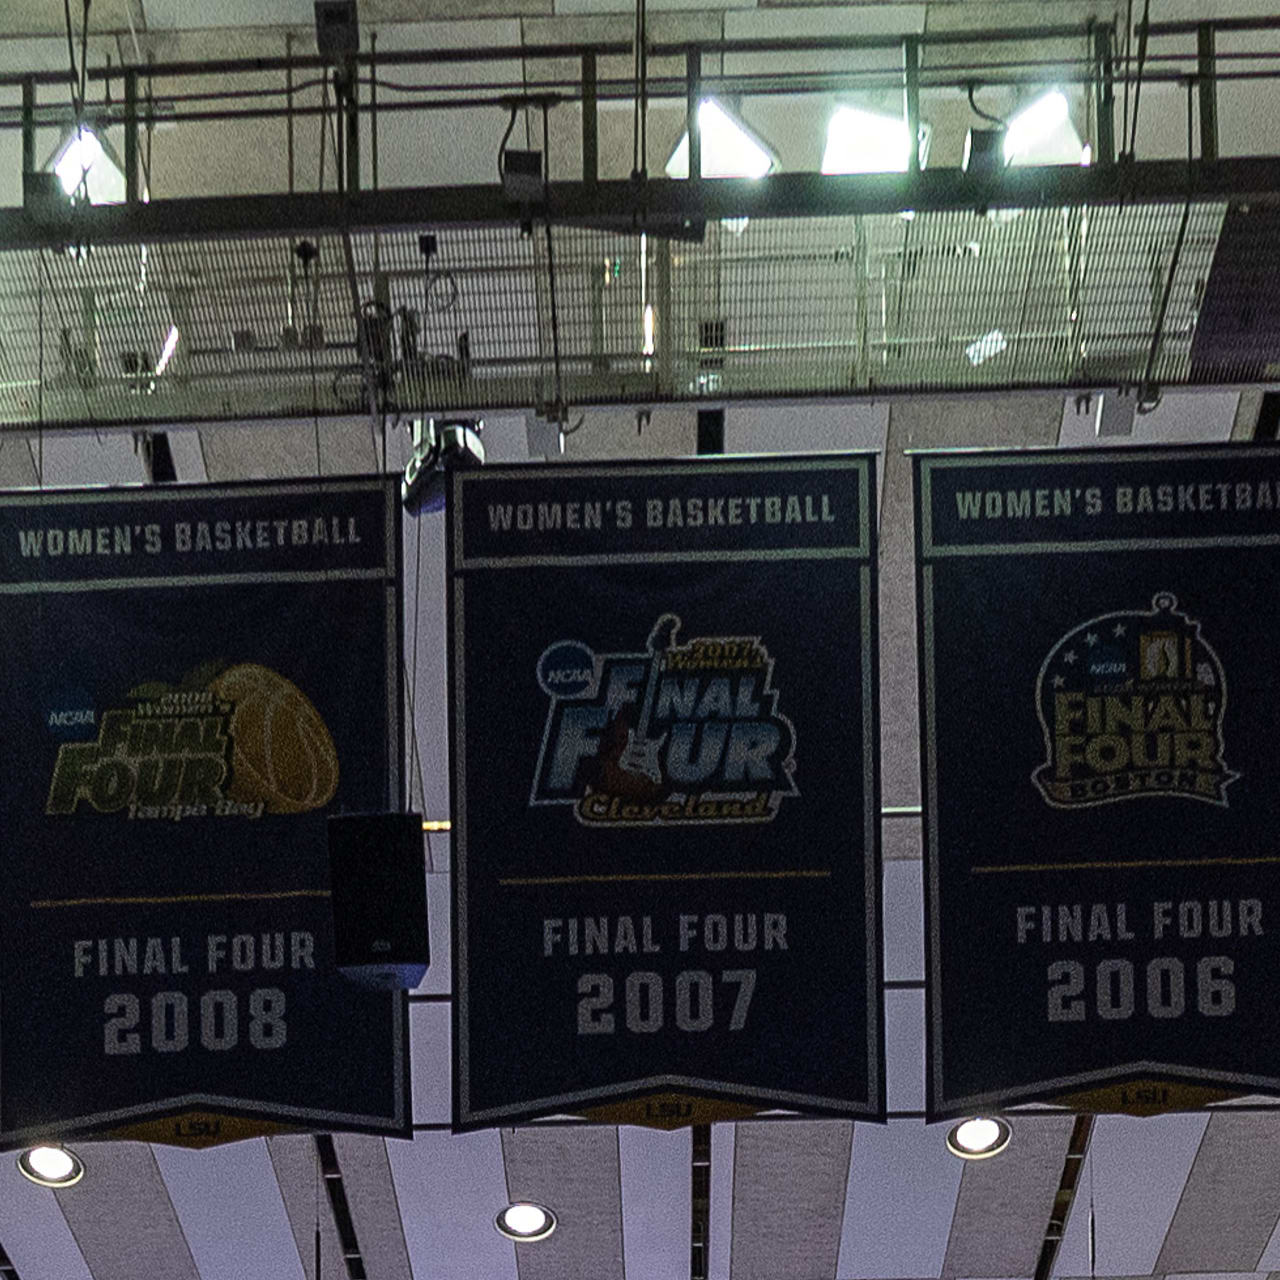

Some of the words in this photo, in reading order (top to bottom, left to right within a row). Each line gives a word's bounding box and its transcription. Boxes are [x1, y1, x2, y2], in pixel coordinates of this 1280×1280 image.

[488, 501, 632, 532] WOMEN'S
[647, 494, 835, 528] BASKETBALL
[955, 486, 1103, 520] WOMEN'S
[19, 524, 162, 558] WOMEN'S
[175, 516, 361, 553] BASKETBALL
[543, 916, 661, 956] FINAL
[679, 912, 790, 951] FOUR
[1017, 904, 1135, 944] FINAL
[1154, 899, 1265, 939] FOUR
[74, 936, 189, 977] FINAL
[207, 931, 315, 974] FOUR
[577, 969, 757, 1035] 2007
[1047, 956, 1236, 1022] 2006
[104, 988, 288, 1056] 2008
[646, 1102, 692, 1119] LSU
